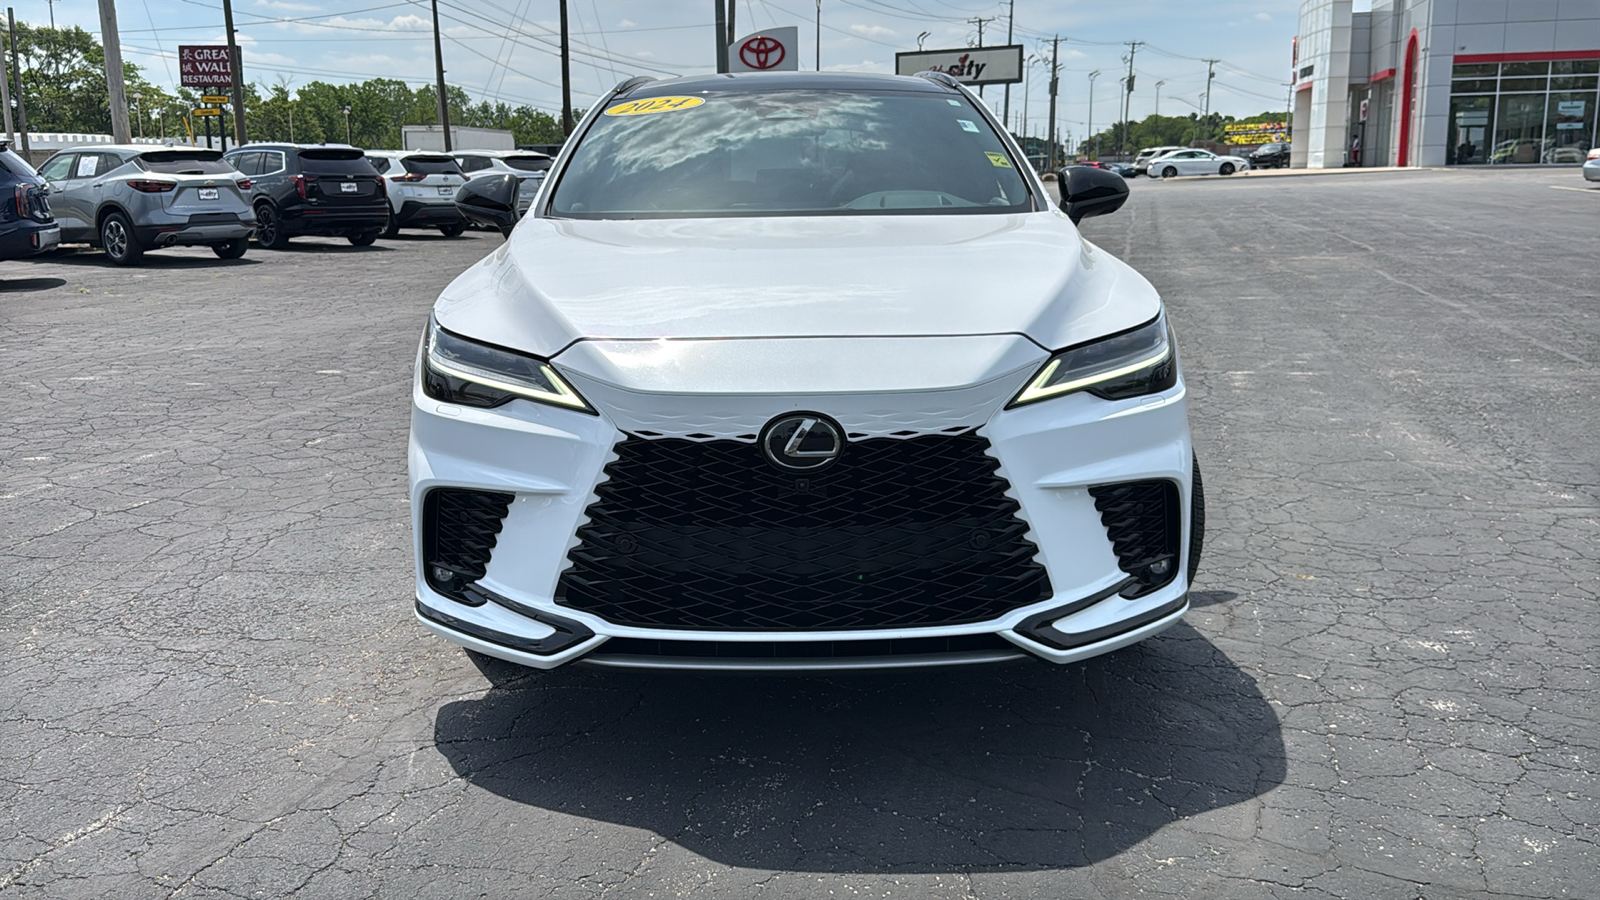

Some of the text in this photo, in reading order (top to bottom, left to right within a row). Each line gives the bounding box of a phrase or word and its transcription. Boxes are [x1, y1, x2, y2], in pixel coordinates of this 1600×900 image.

[194, 49, 229, 60] GREA
[182, 75, 232, 83] RESTAURAN
[615, 98, 692, 115] 2024
